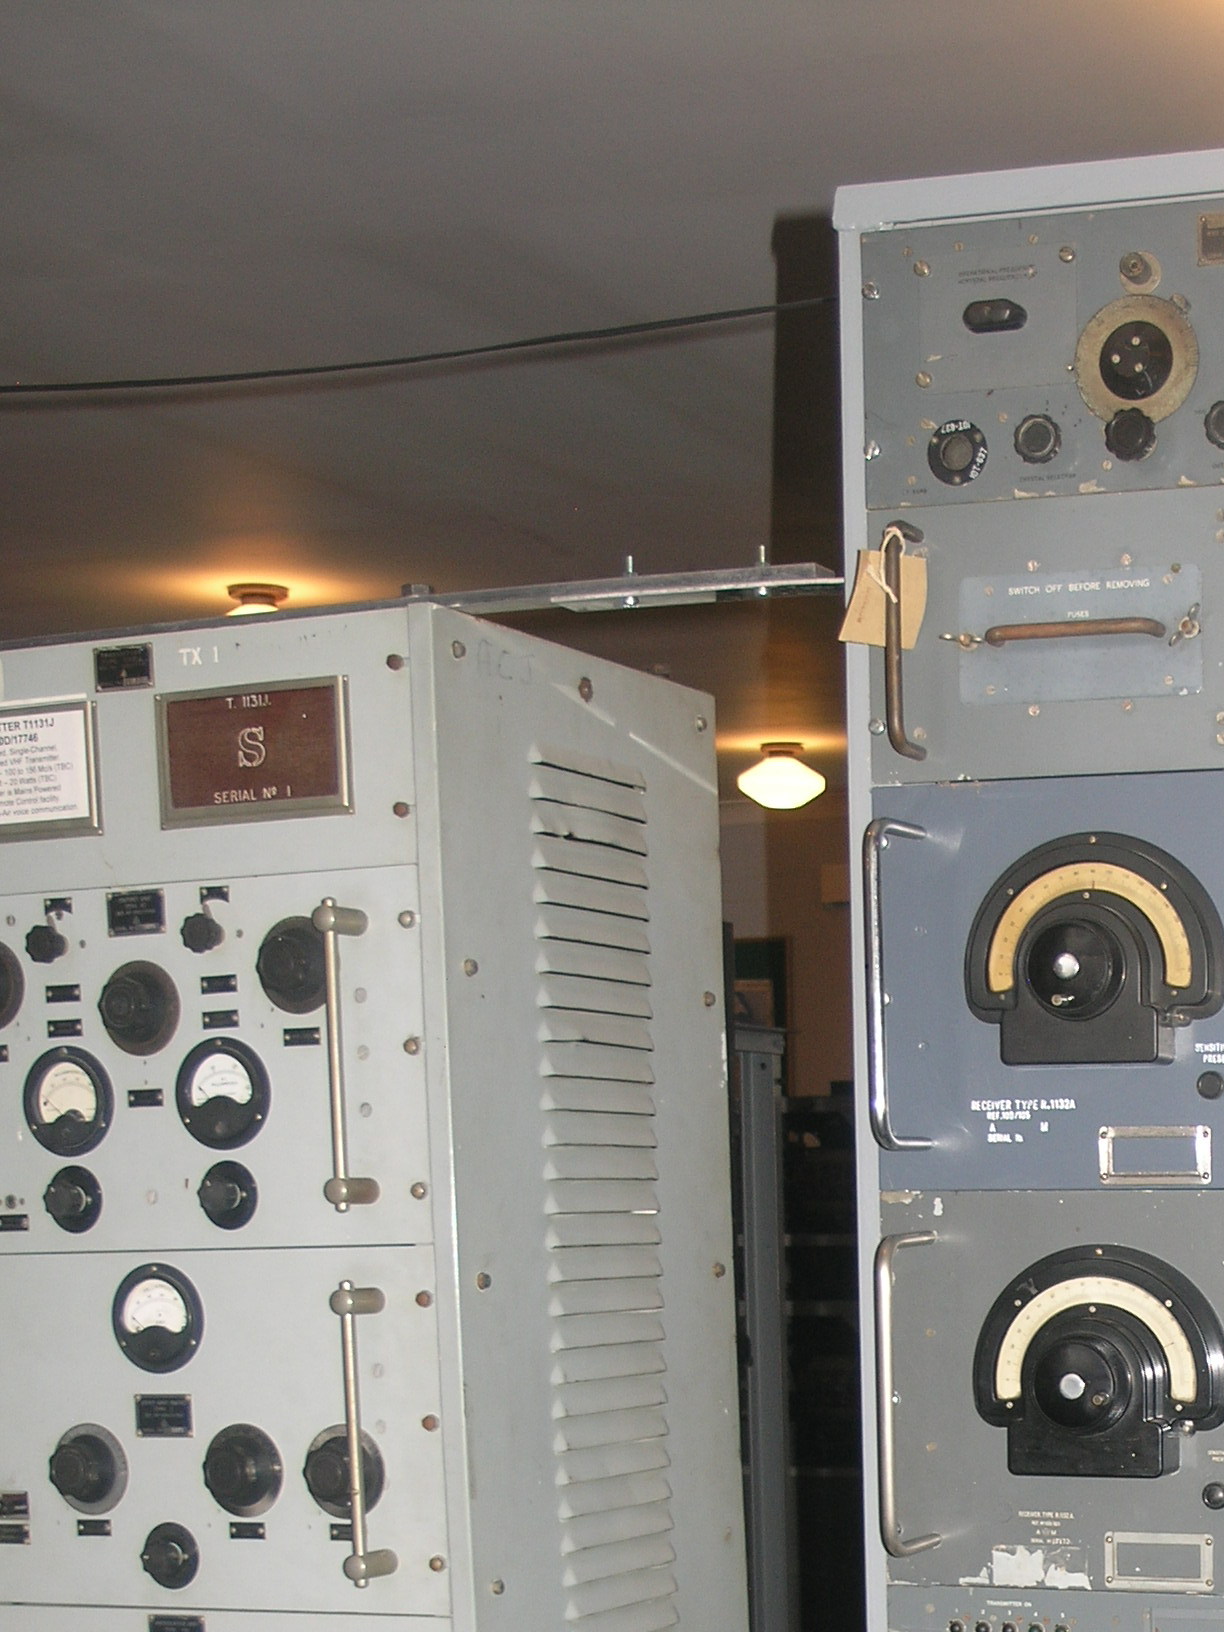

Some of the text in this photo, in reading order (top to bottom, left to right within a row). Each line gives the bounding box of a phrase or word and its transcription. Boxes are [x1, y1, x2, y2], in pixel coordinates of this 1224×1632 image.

[1008, 578, 1150, 596] SWITCH OFF BEFORE REMOVING
[178, 646, 220, 666] TX 1
[237, 725, 266, 768] S
[213, 788, 257, 805] SERIAL
[971, 1099, 1012, 1111] RECEIVER
[1015, 1099, 1039, 1110] TYPE
[988, 1122, 996, 1132] A
